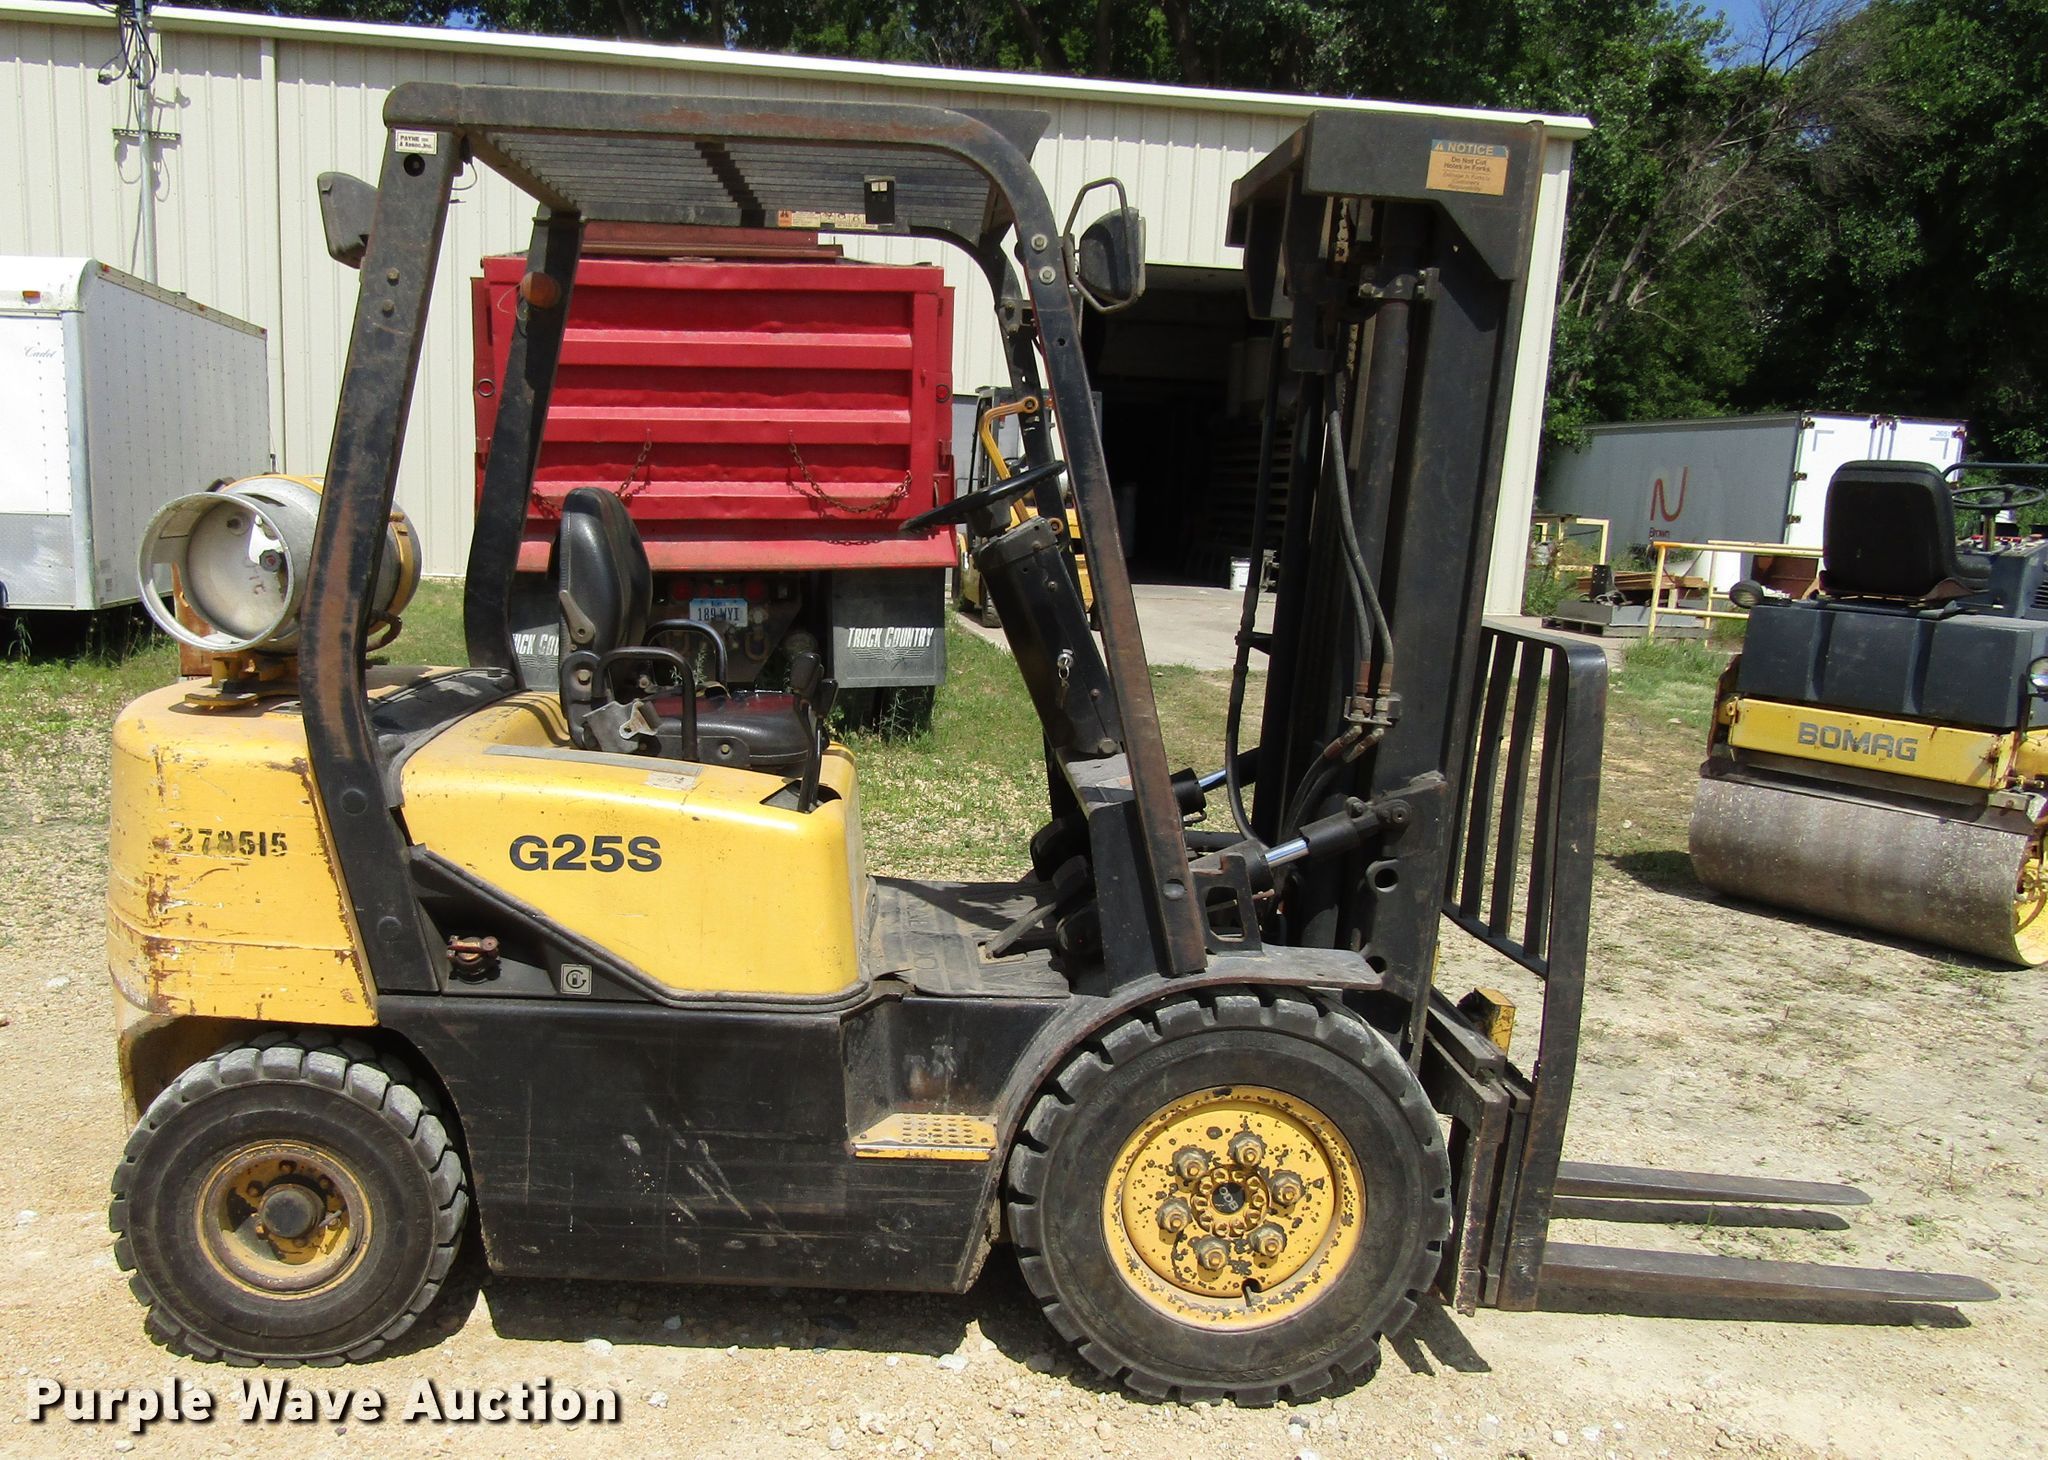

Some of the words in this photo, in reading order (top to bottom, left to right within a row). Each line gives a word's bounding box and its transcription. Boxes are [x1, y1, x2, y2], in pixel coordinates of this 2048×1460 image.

[1447, 142, 1494, 156] NOTICE
[847, 627, 883, 648] TRUCK
[884, 626, 935, 648] COUNTRY
[1797, 722, 1919, 762] BOMAG
[509, 833, 663, 873] G25S
